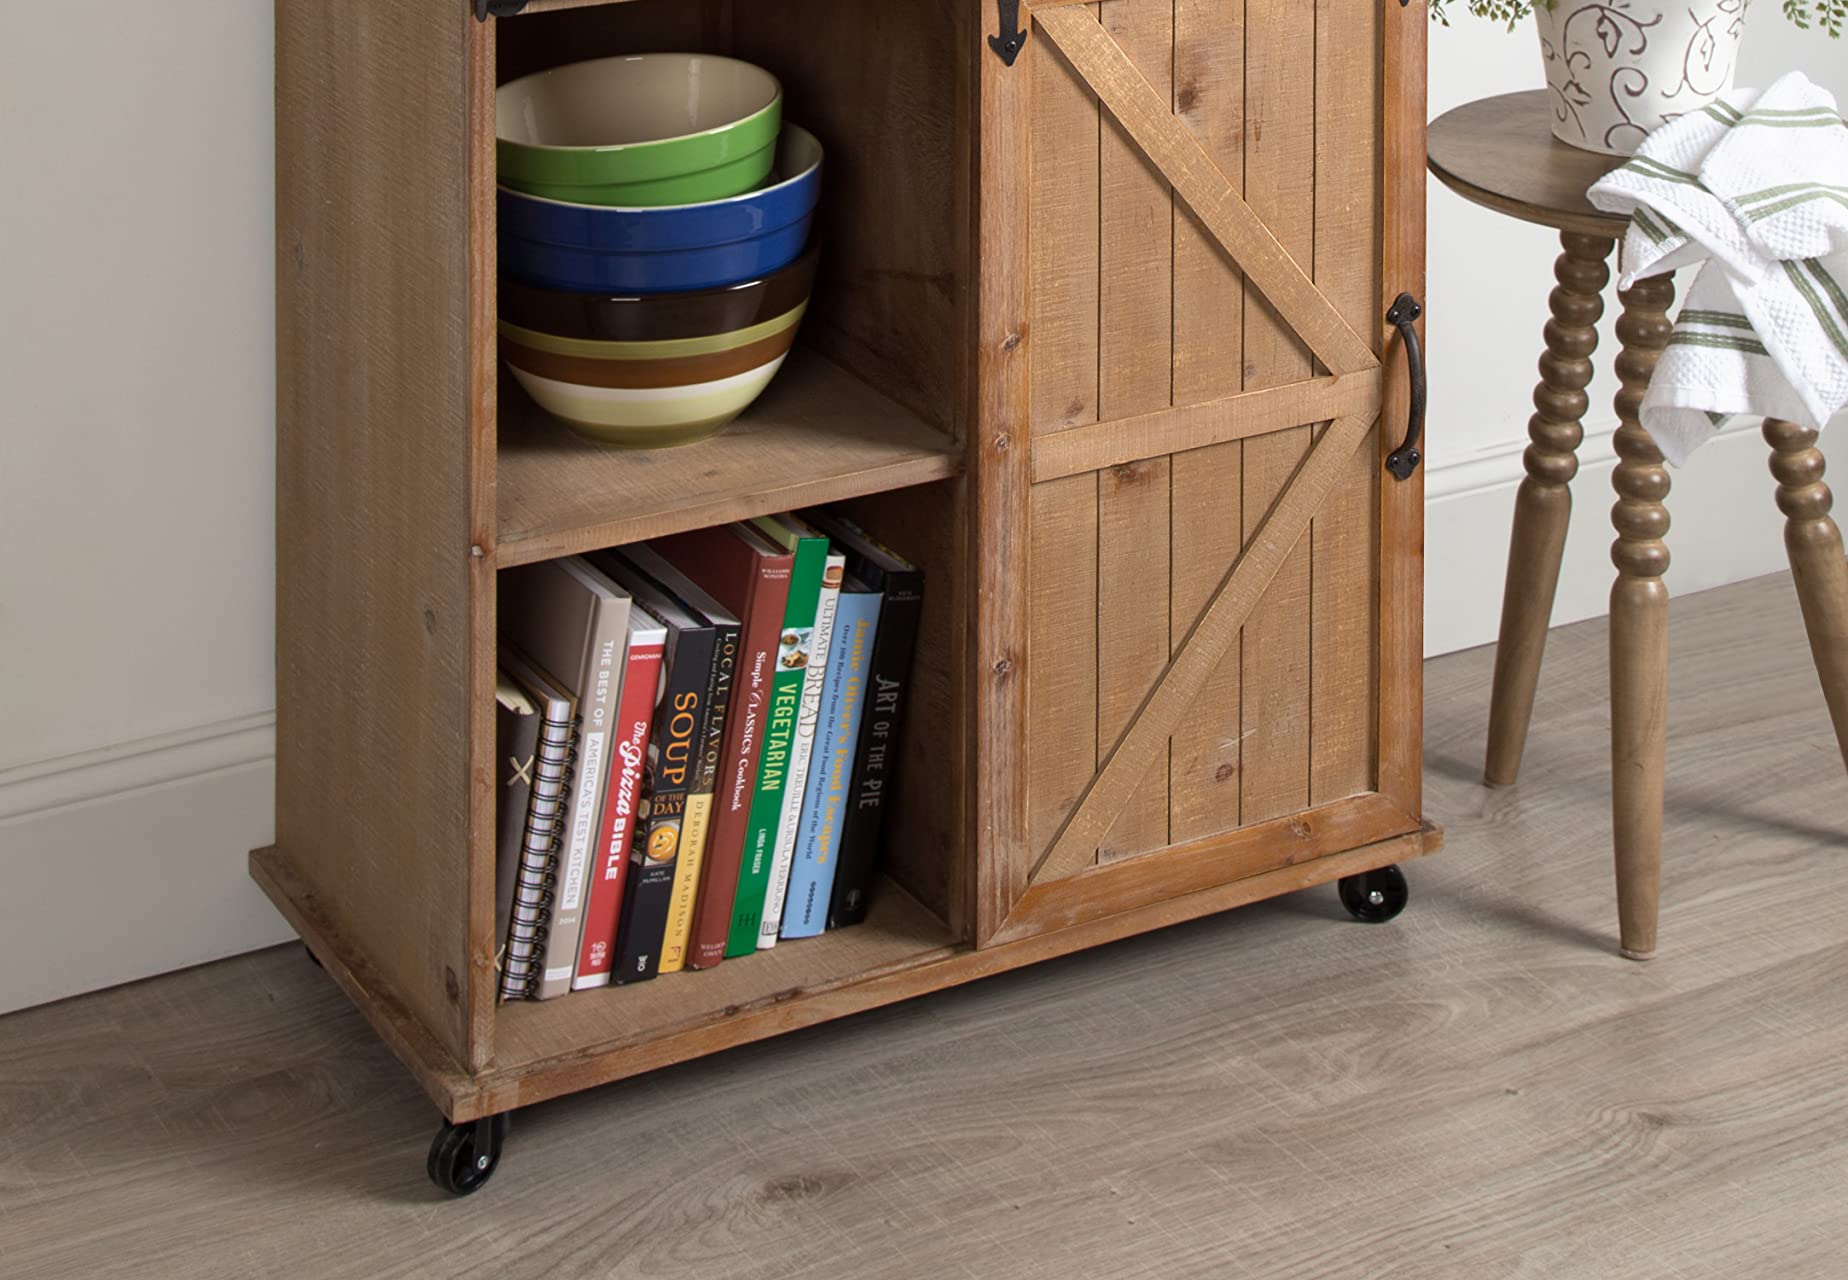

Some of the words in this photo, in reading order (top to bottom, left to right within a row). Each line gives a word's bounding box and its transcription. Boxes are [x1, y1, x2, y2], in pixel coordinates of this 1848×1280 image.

[815, 598, 835, 660] ULTIMATE
[841, 624, 850, 645] Over
[851, 618, 869, 672] Jamie
[601, 640, 614, 666] THE
[716, 632, 737, 695] LOCAL
[752, 651, 767, 688] Simple
[596, 671, 609, 702] BEST
[833, 661, 844, 693] Recipes
[875, 674, 899, 713] ART
[593, 708, 604, 726] OF
[798, 665, 825, 737] BREAD
[830, 694, 839, 714] from
[838, 676, 859, 743] Oliver's
[632, 721, 647, 745] The
[663, 692, 698, 785] SOUP
[742, 689, 764, 754] CLASSICS
[761, 683, 797, 791] VEGETARIAN
[873, 721, 890, 738] OF
[702, 704, 726, 786] FLAVORS
[824, 730, 833, 754] Great
[867, 744, 886, 771] THE
[580, 739, 599, 811] AMERICA'S
[616, 741, 642, 816] Pizza
[821, 755, 829, 775] Food
[831, 748, 849, 790] Food
[654, 793, 666, 802] OF
[667, 792, 685, 801] THE
[732, 758, 748, 811] Cookbook
[814, 776, 826, 808] Regions
[859, 779, 882, 809] PIE
[577, 813, 589, 842] TEST
[653, 801, 684, 816] DAY
[811, 820, 819, 833] the
[605, 817, 626, 880] BIBLE
[687, 801, 704, 867] DEBORAH
[806, 835, 816, 859] World
[817, 795, 840, 864] Escapes
[566, 847, 585, 905] KITCHEN
[675, 873, 692, 937] MADISON
